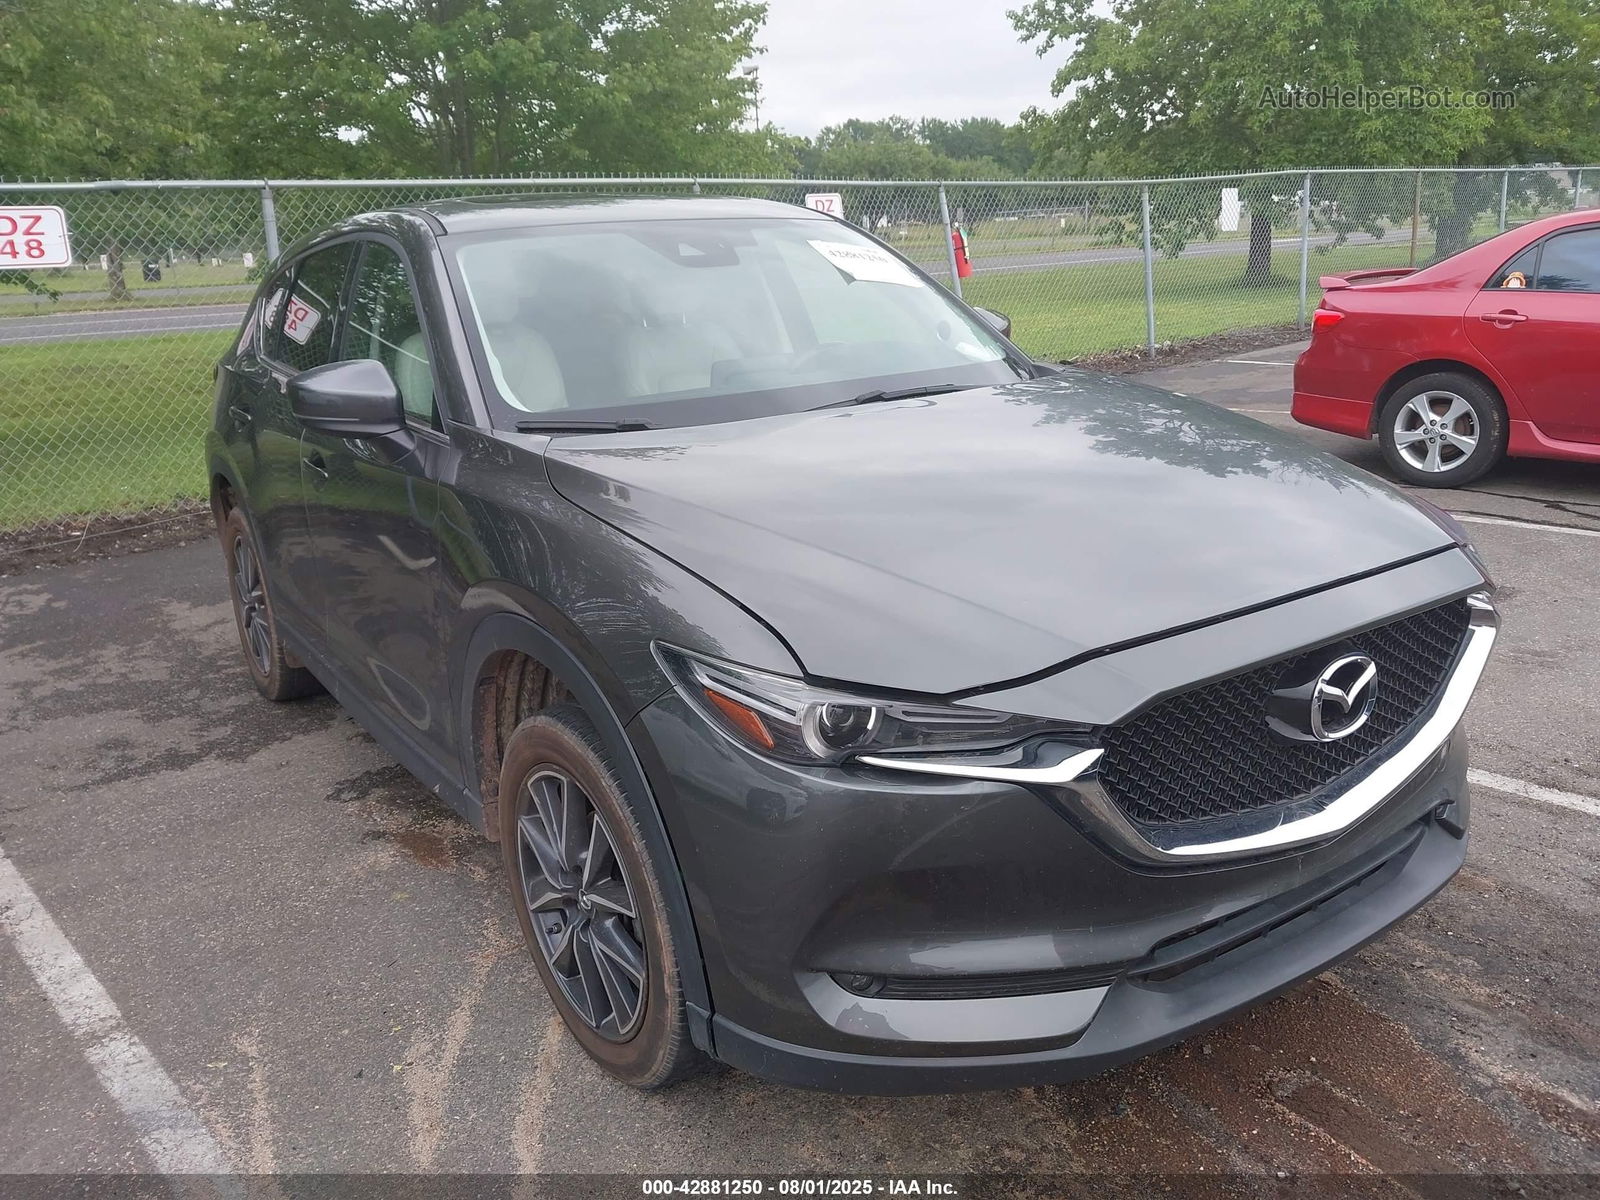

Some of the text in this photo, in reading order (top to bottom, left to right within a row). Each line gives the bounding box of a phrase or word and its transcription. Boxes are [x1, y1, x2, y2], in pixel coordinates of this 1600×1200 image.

[815, 199, 835, 213] DZ
[0, 215, 45, 236] DZ
[0, 239, 45, 258] 48
